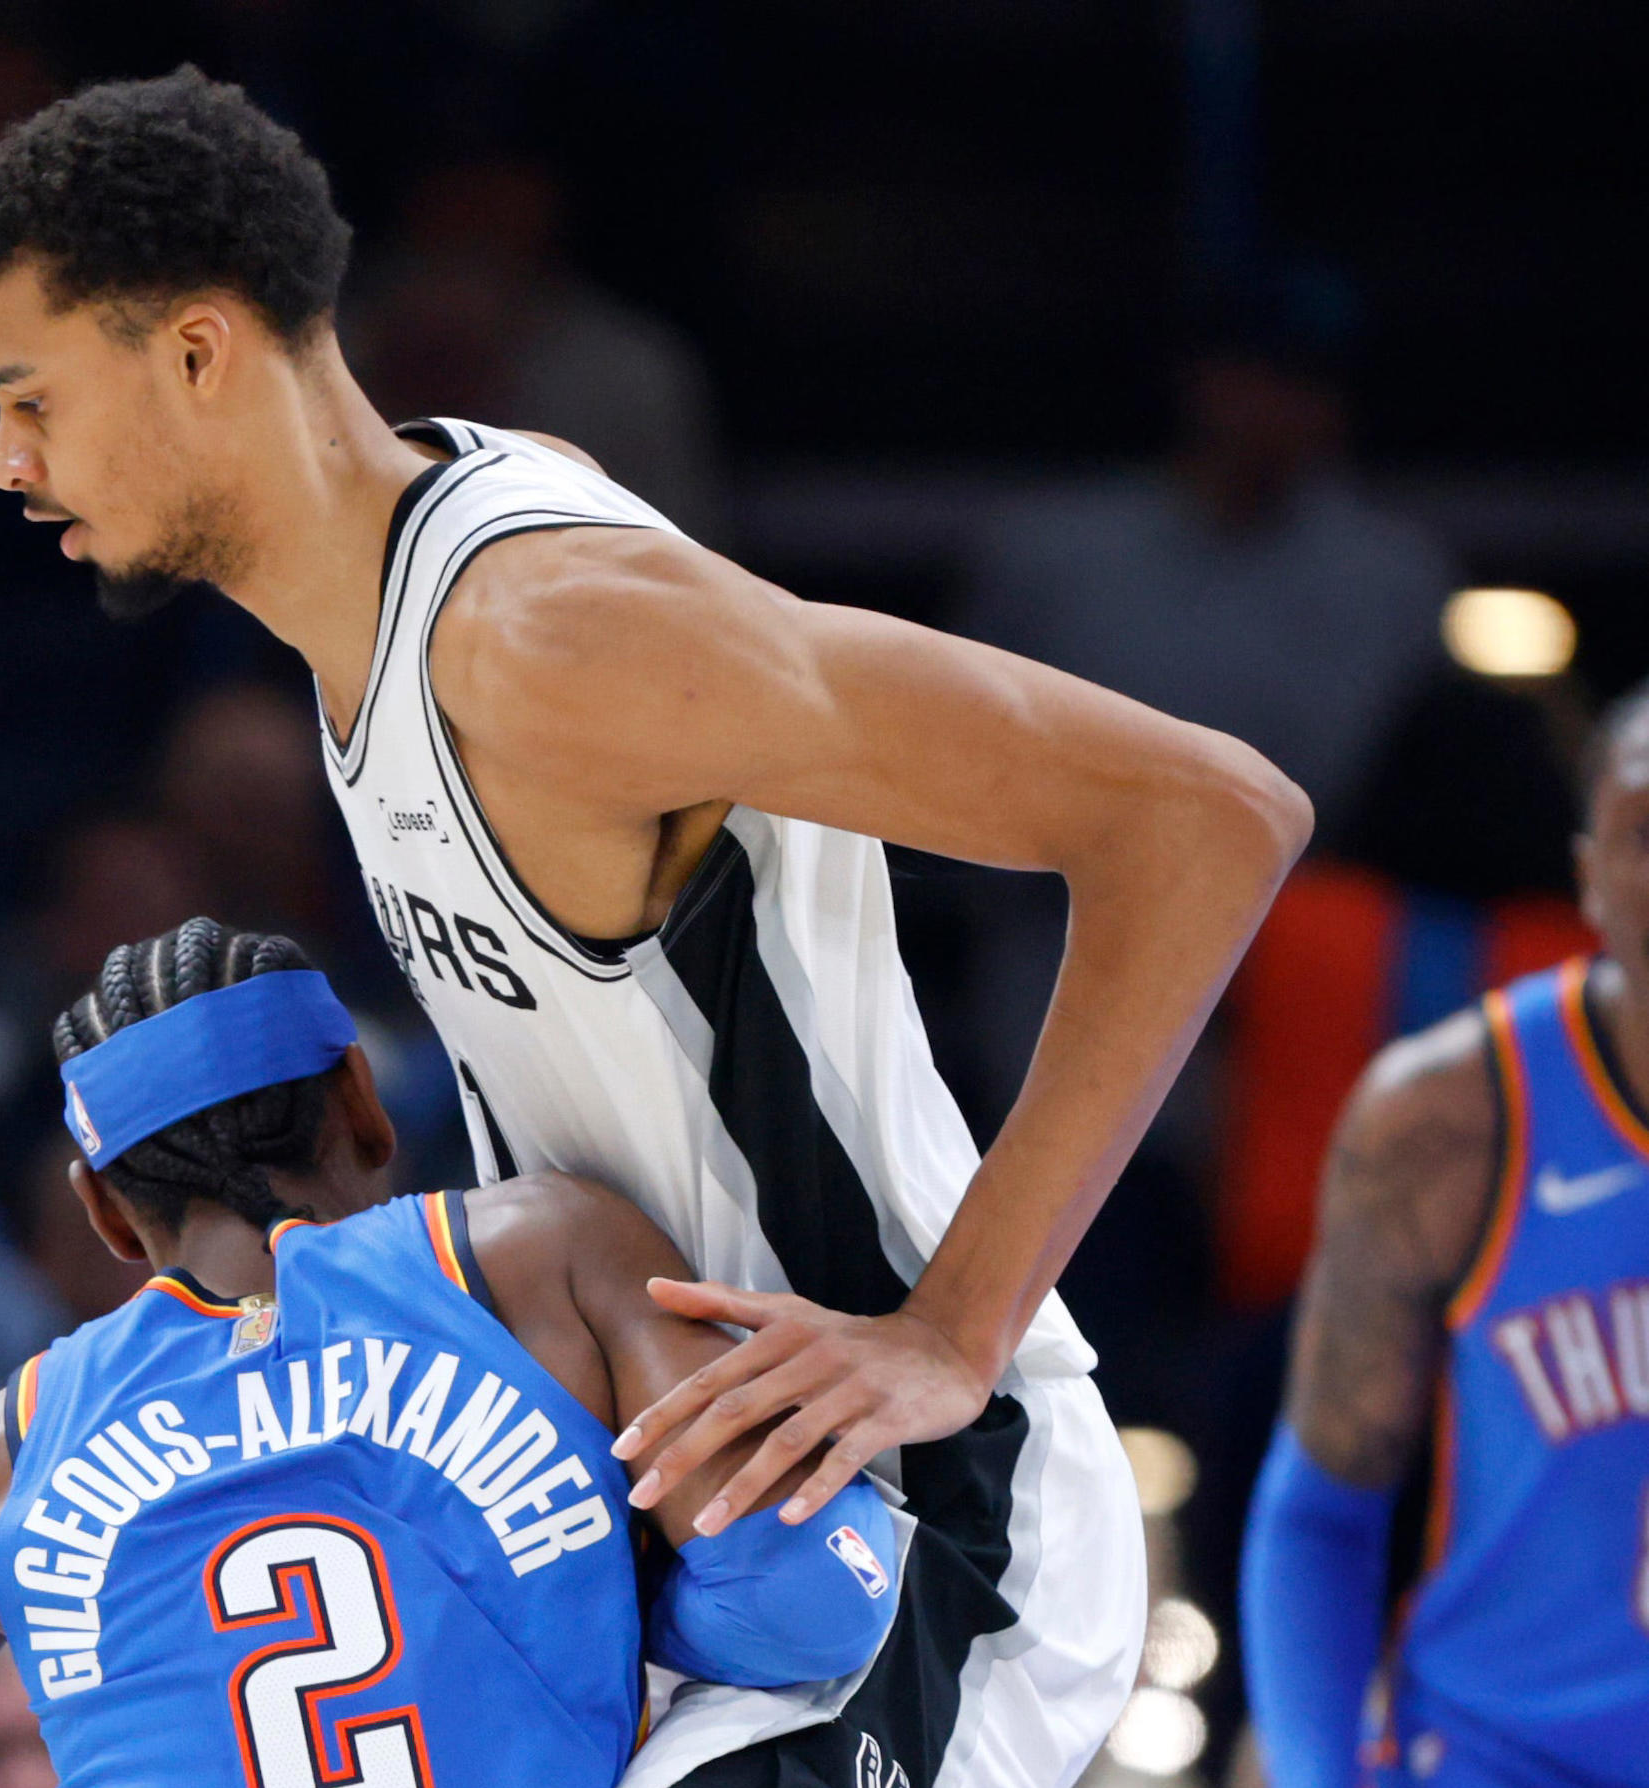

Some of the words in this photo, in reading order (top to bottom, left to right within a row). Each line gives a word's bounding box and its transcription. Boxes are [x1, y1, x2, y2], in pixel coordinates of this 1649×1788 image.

[387, 811, 437, 831] LEDGER
[370, 874, 538, 1011] URS
[14, 1337, 613, 1702] GILGEOUS-ALEXANDER
